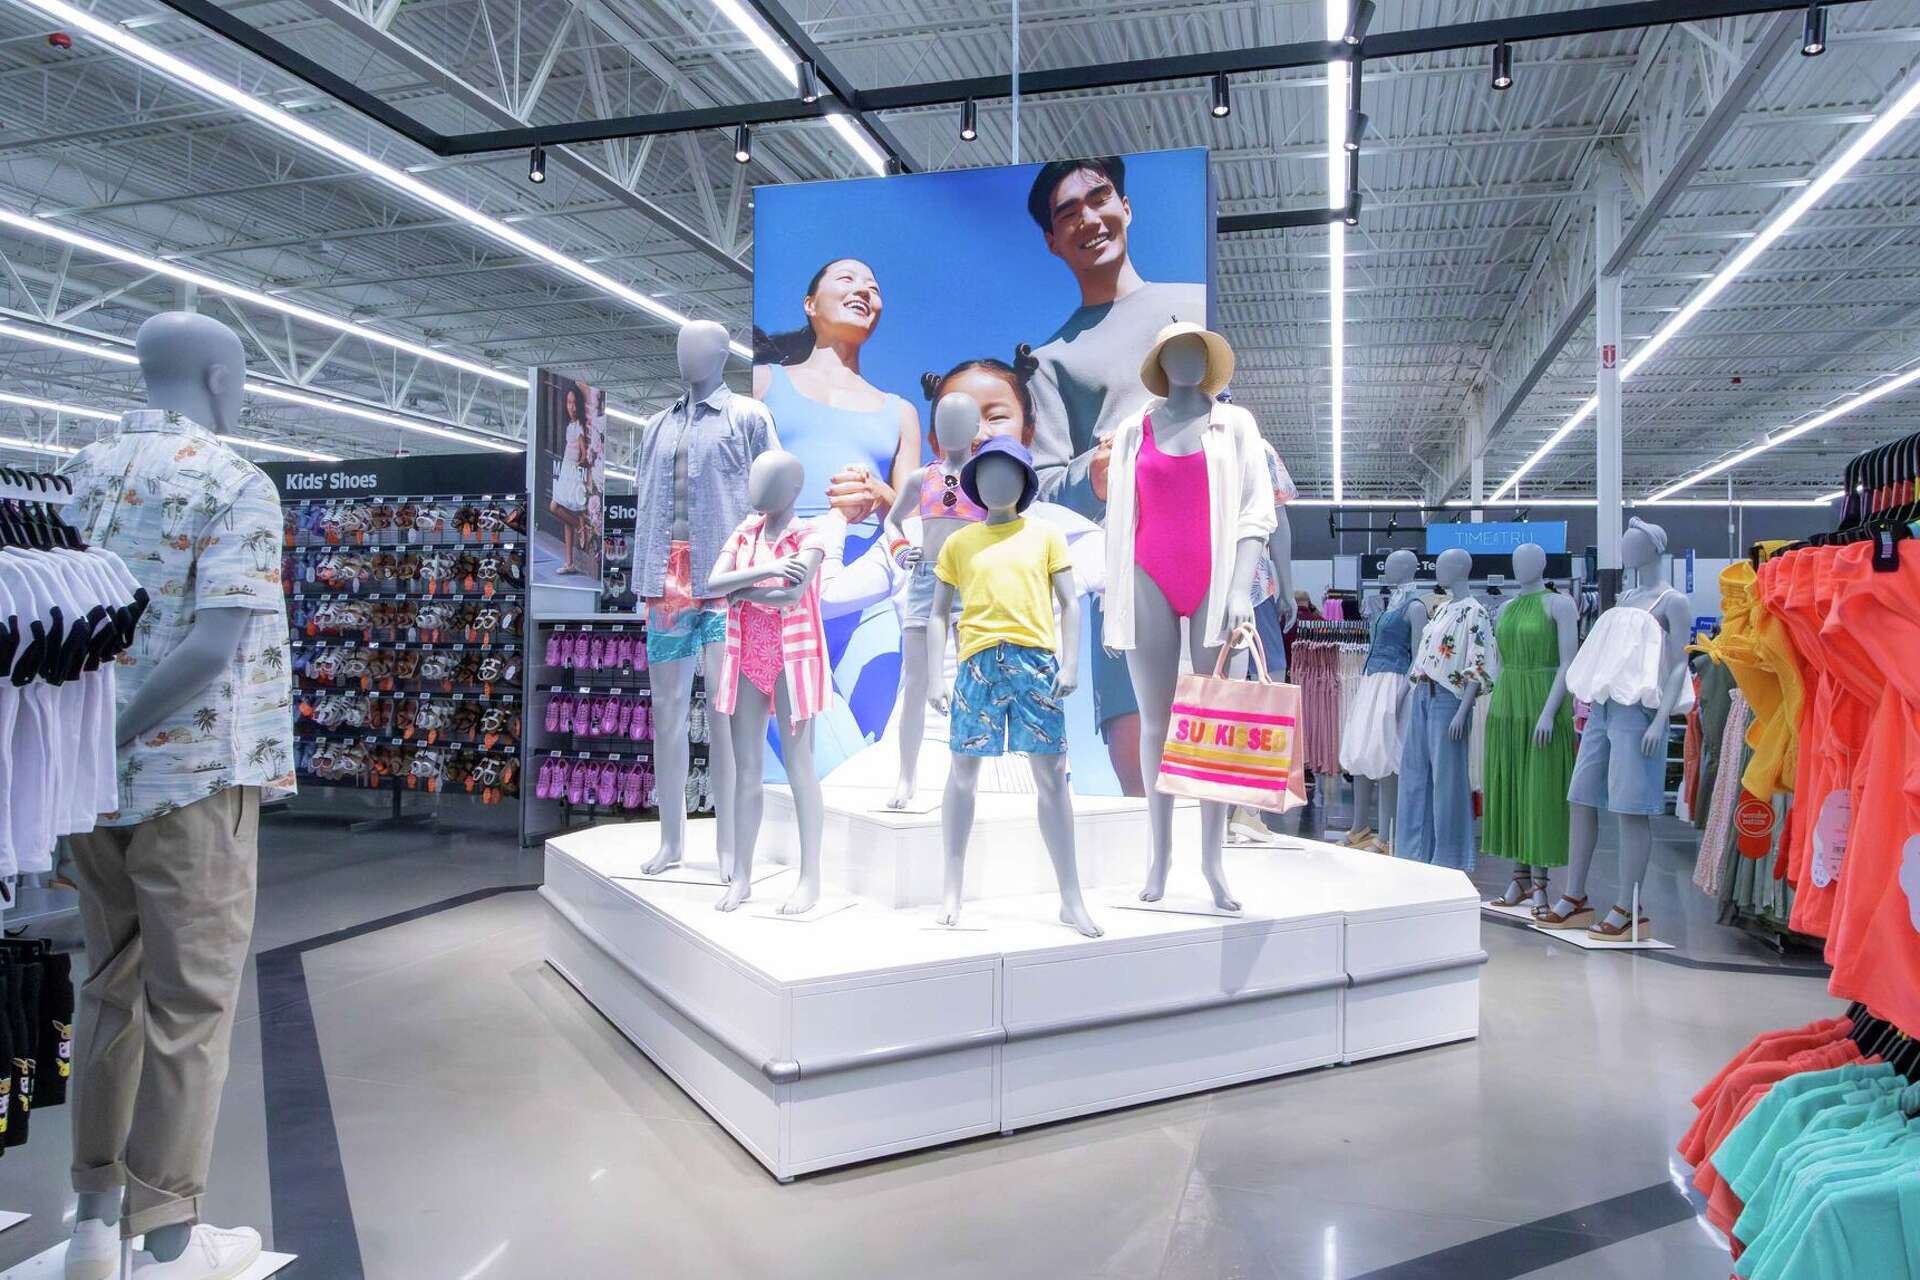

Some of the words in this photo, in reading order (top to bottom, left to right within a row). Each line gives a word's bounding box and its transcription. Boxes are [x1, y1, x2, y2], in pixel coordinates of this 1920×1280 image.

[330, 472, 377, 489] Shoes
[609, 505, 637, 520] Sho
[1175, 720, 1286, 752] SUNKISSED
